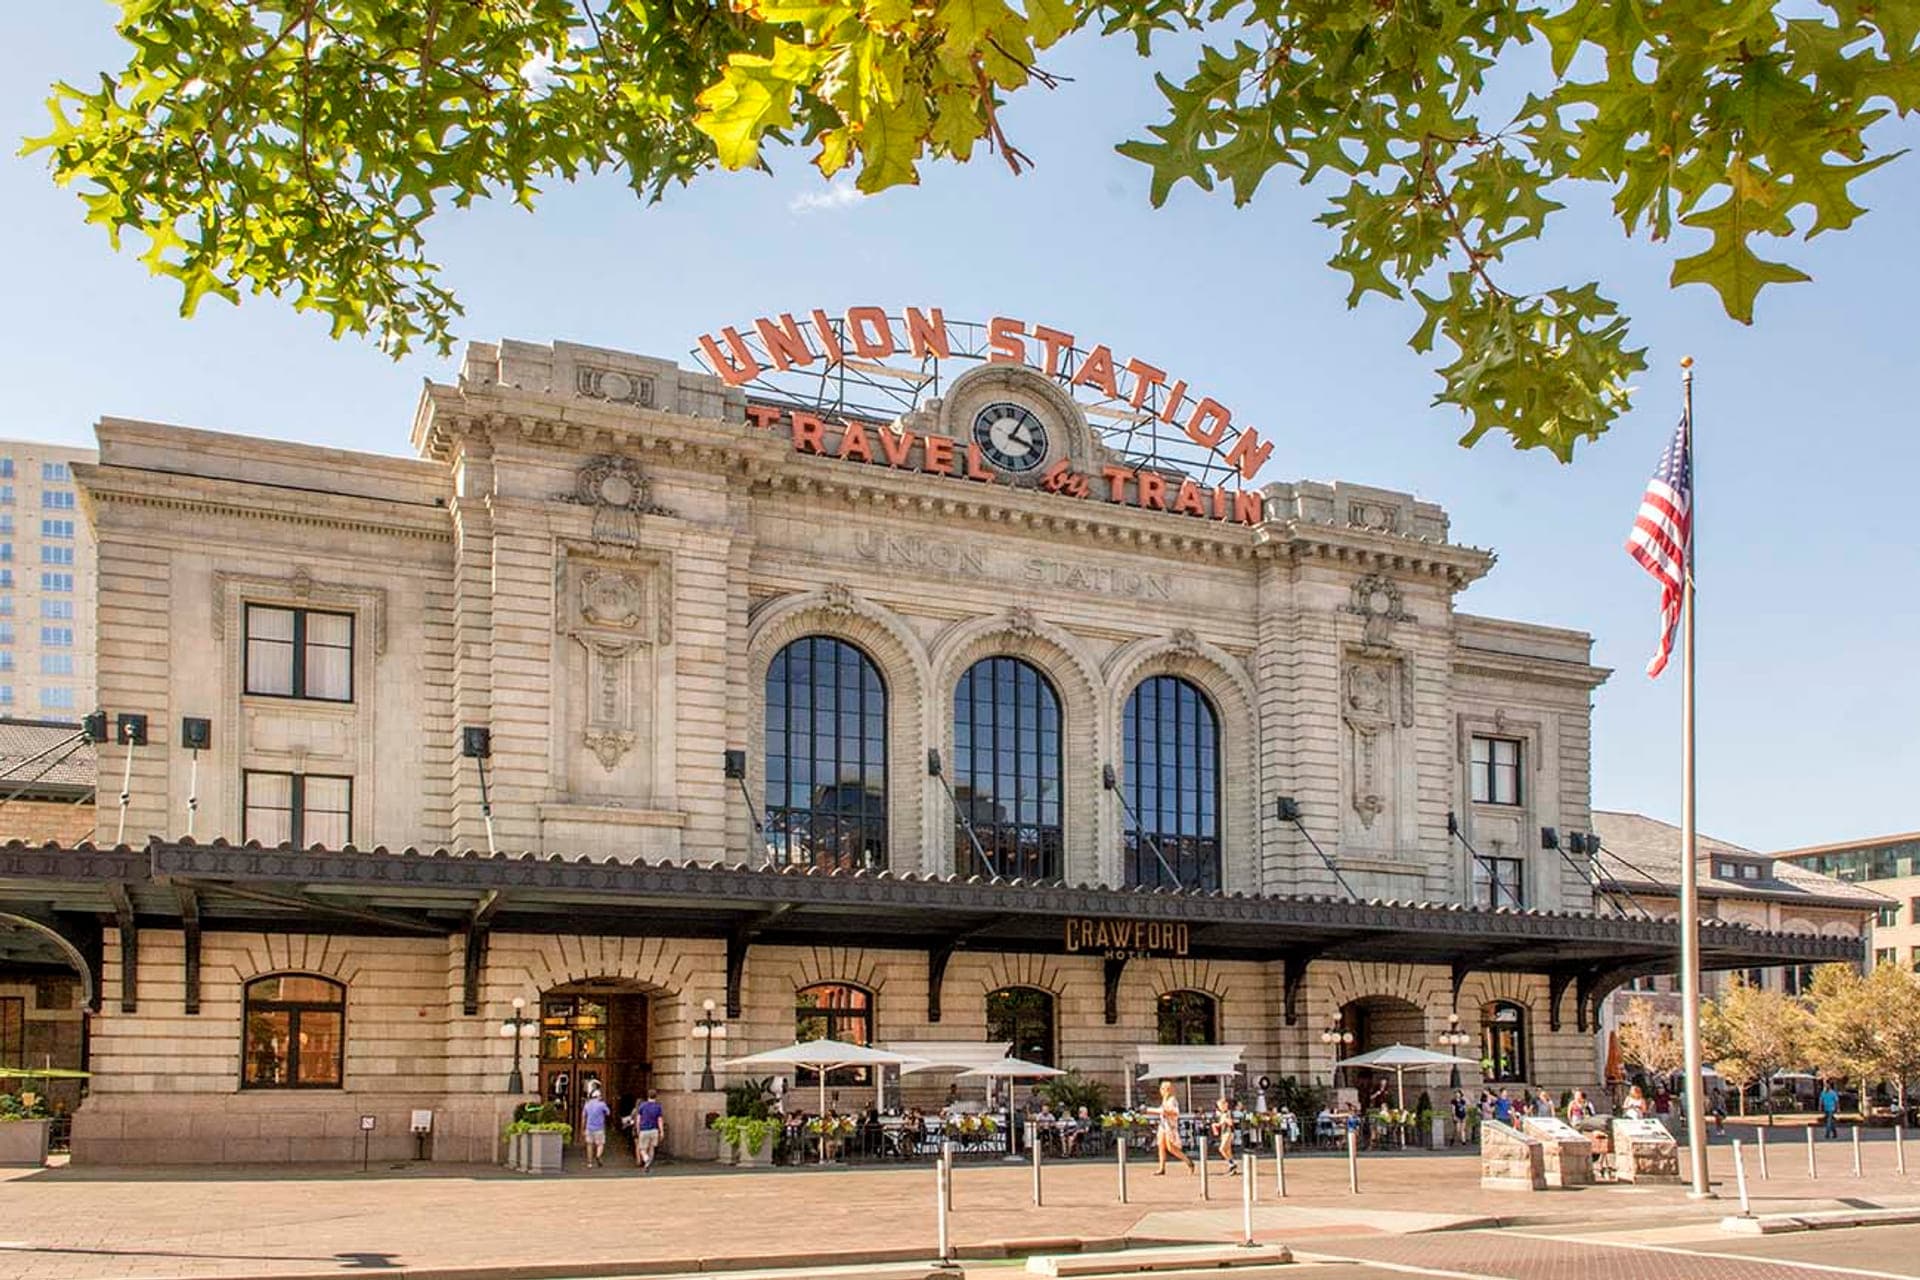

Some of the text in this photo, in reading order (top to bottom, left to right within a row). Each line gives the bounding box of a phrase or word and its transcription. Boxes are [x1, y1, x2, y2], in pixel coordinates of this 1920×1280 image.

[698, 307, 950, 386] UNION
[986, 317, 1275, 480] STATION
[745, 405, 996, 482] TRAVEL
[1102, 465, 1265, 526] TRAIN
[853, 530, 1172, 600] UNION STATION
[1066, 919, 1189, 955] CRAWFORD
